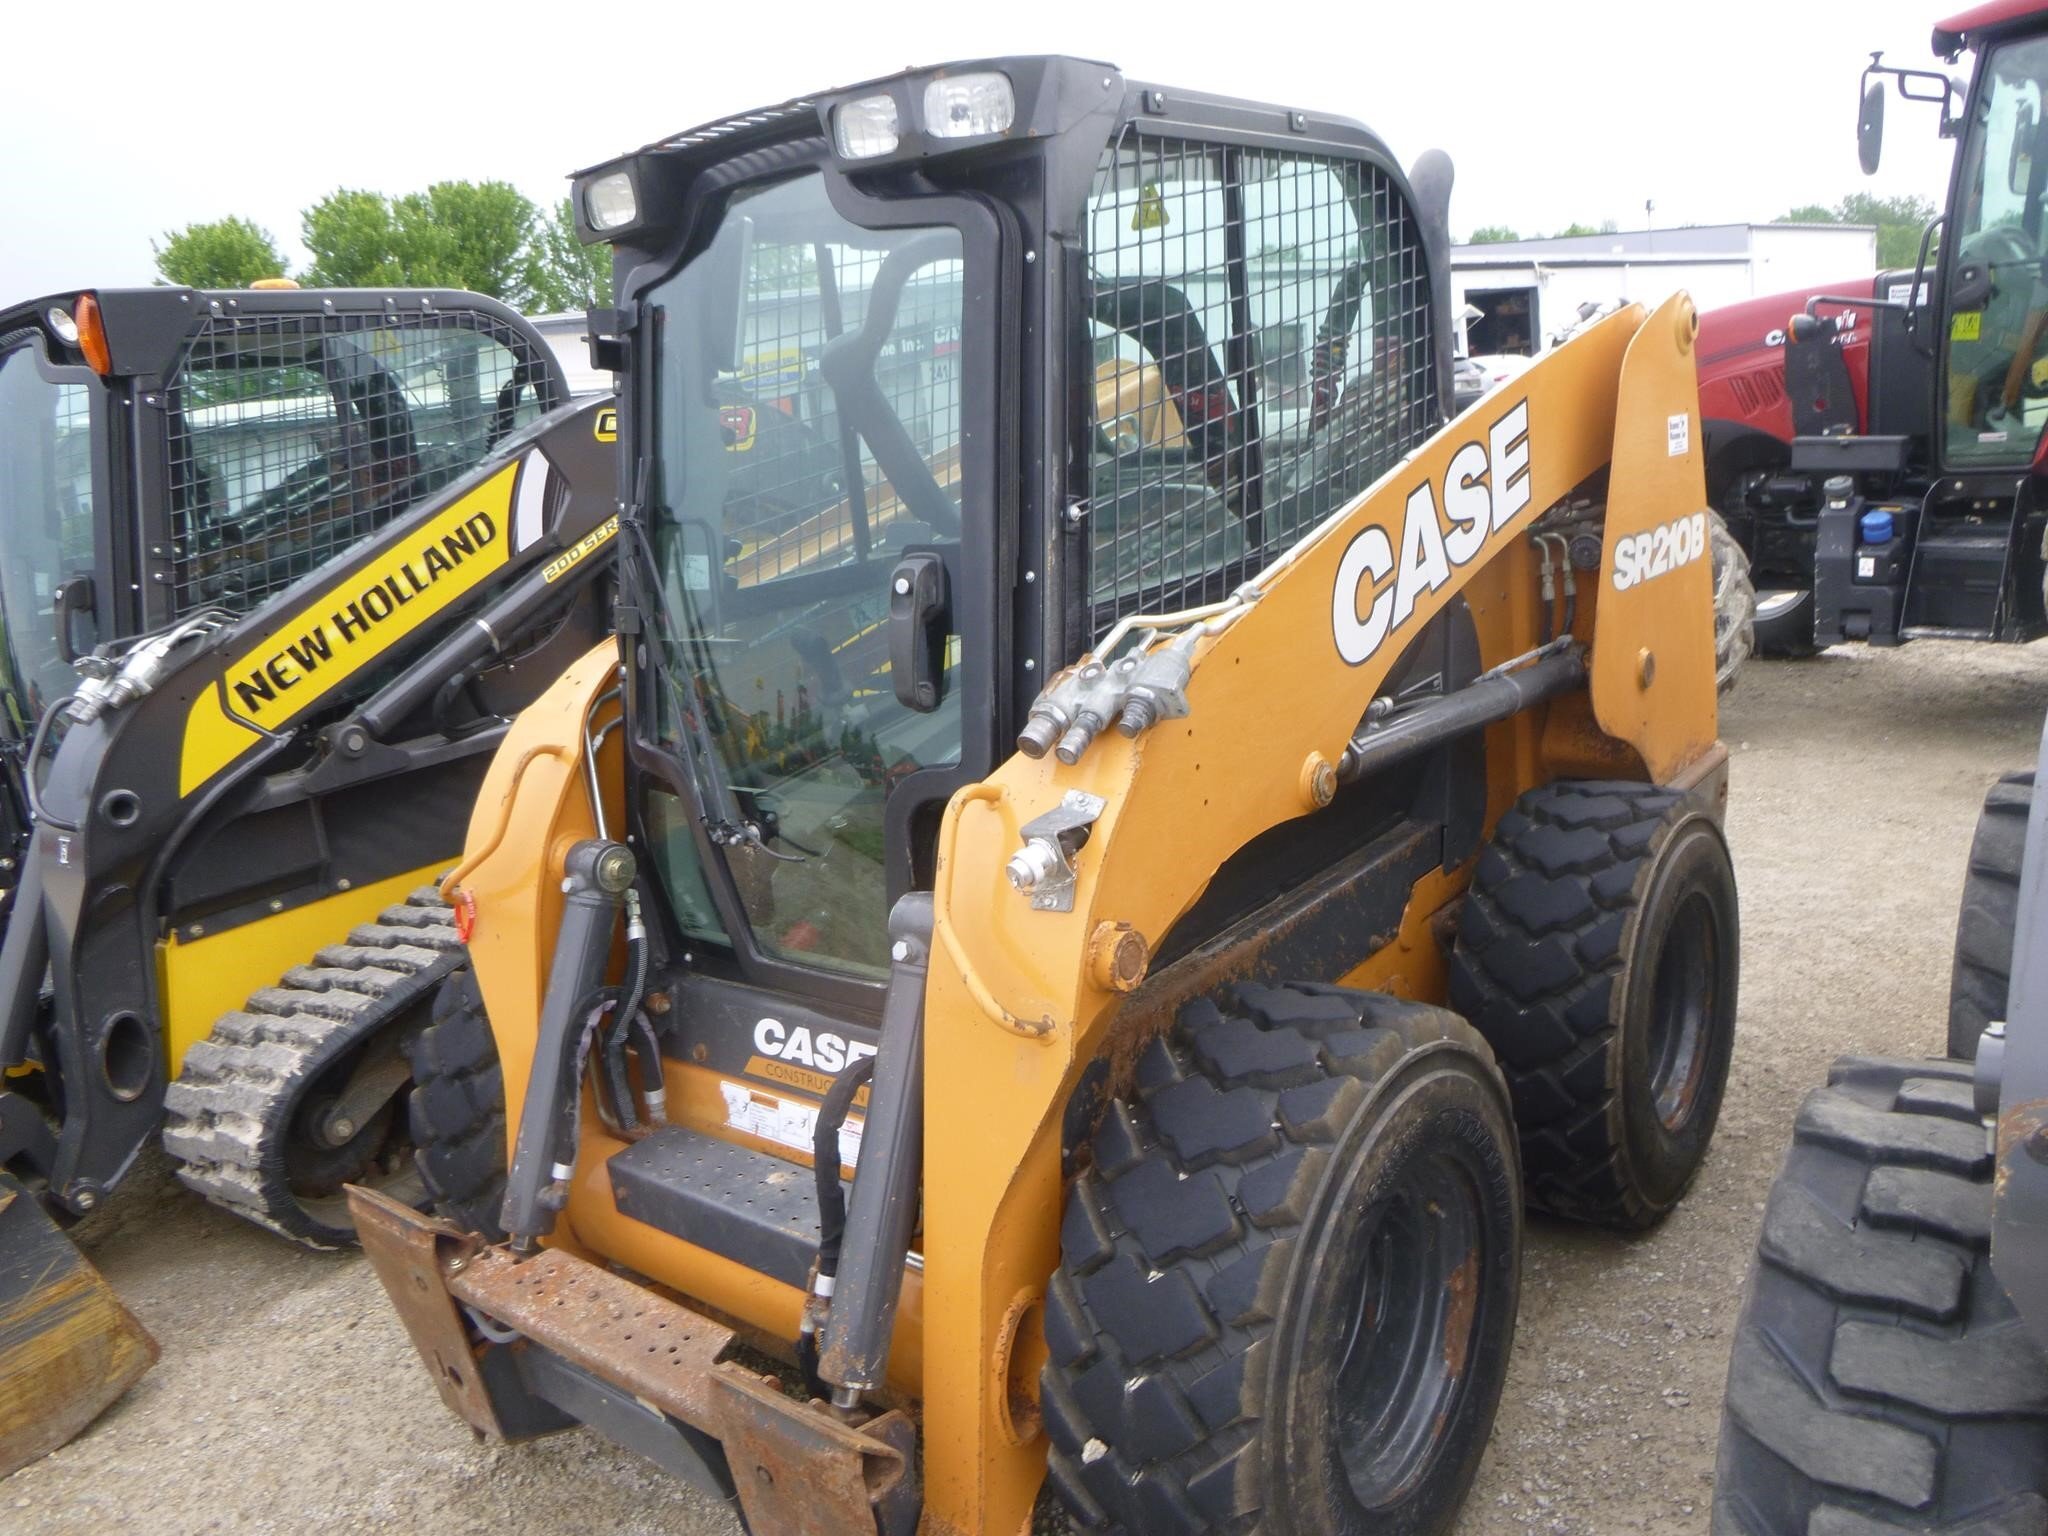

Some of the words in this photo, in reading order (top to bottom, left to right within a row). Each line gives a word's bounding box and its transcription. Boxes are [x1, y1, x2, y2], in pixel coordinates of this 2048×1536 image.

[543, 548, 581, 581] 200
[584, 518, 618, 548] SER
[1332, 396, 1531, 667] CASE
[1612, 511, 1706, 592] SR210B
[233, 625, 334, 714] NEW
[330, 511, 497, 645] HOLLAND
[766, 1062, 866, 1103] CONSTRUCN
